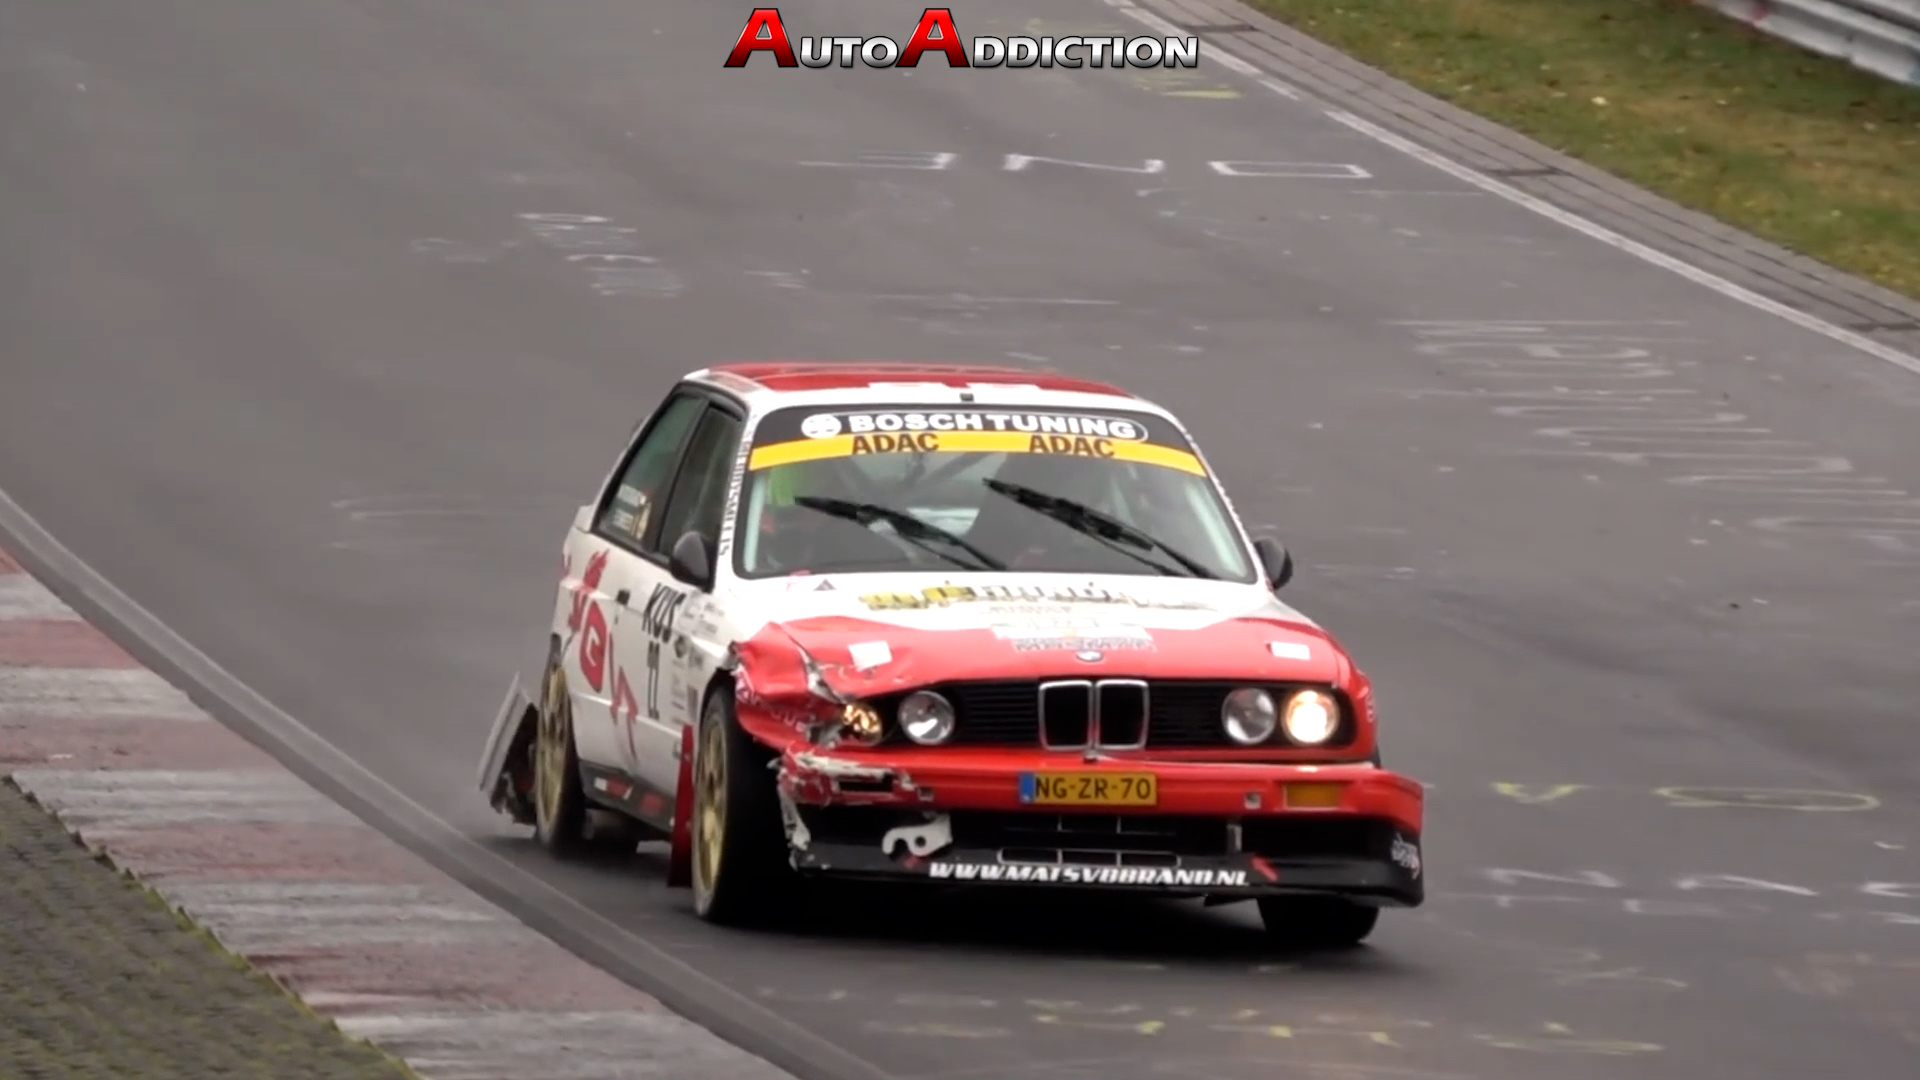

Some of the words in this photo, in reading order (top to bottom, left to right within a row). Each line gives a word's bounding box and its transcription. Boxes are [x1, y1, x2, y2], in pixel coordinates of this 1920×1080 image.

[848, 412, 984, 433] BOSCH
[985, 413, 1138, 439] TUNING
[851, 432, 939, 455] ADAC
[1028, 433, 1115, 458] ADAC
[1035, 775, 1151, 800] NG-ZR-70
